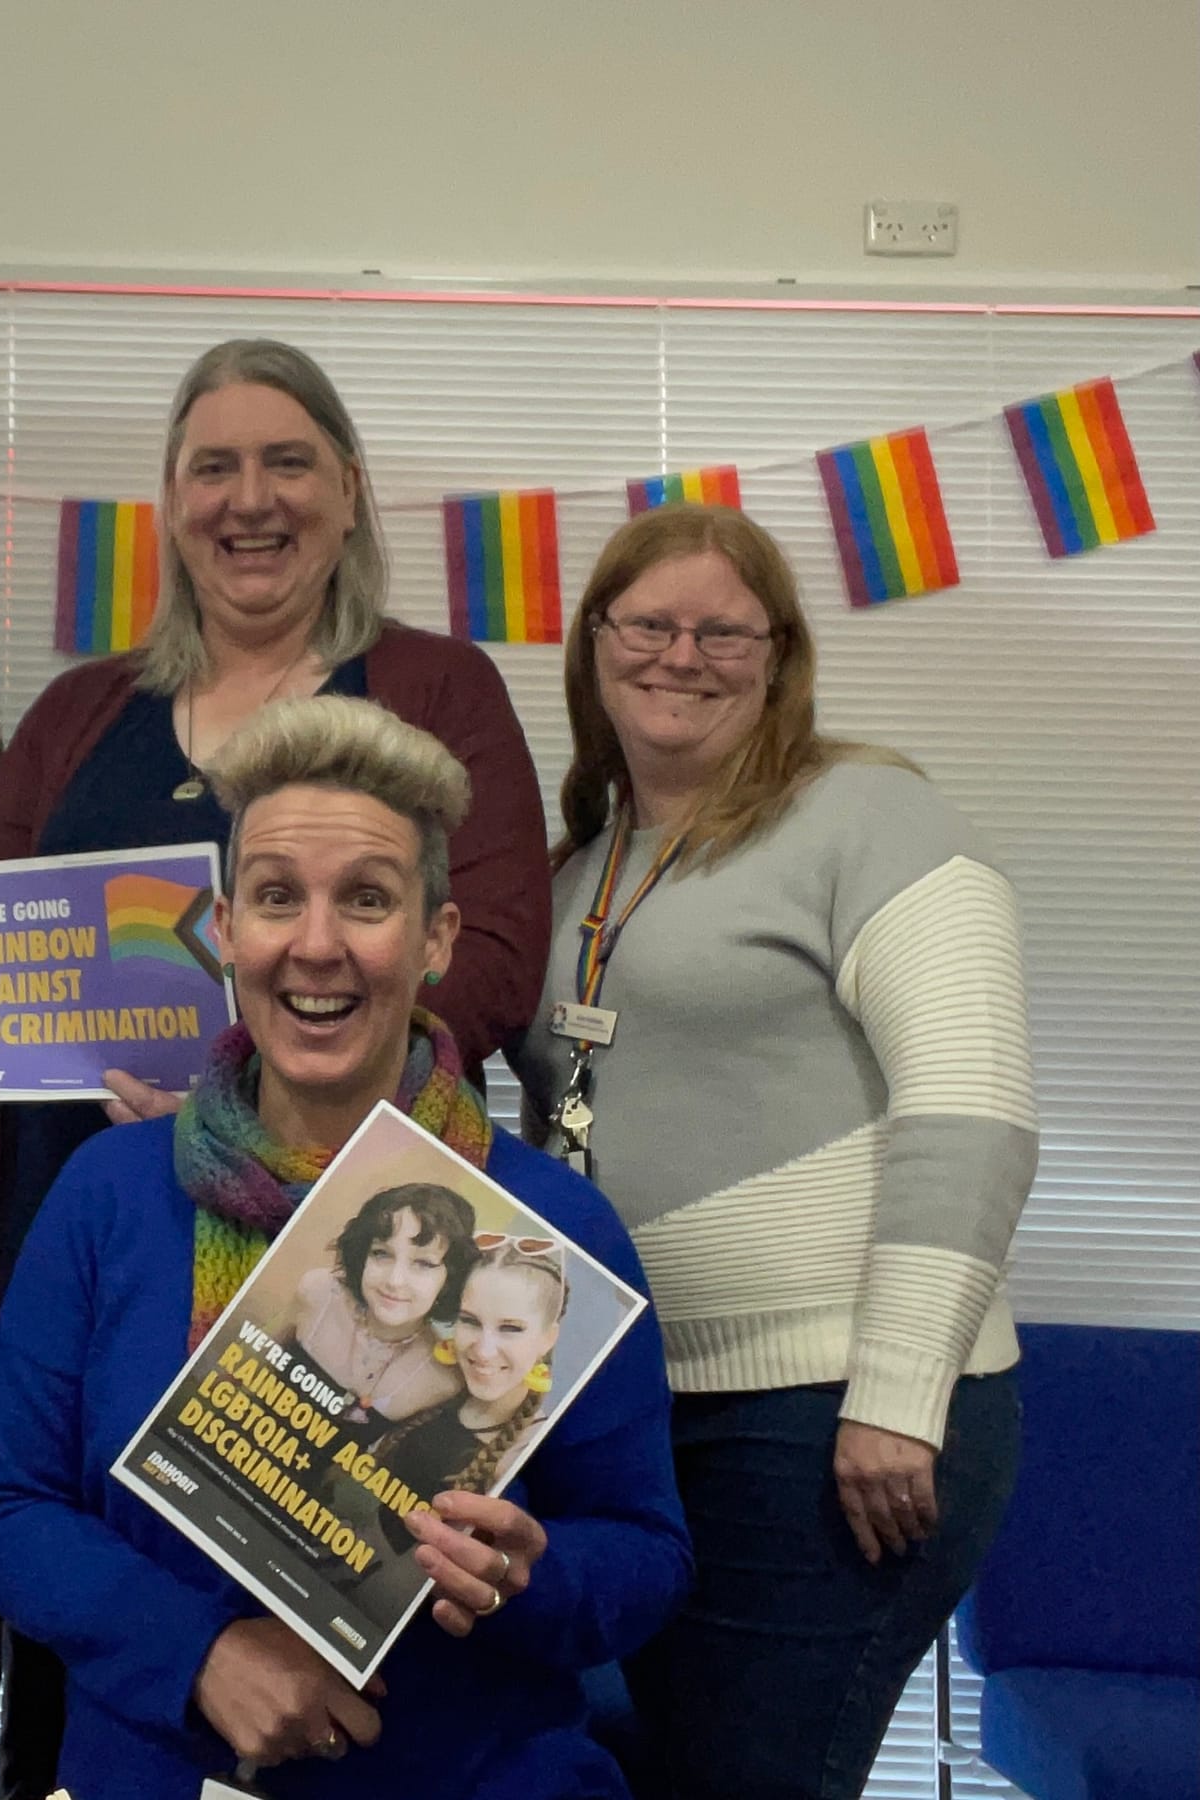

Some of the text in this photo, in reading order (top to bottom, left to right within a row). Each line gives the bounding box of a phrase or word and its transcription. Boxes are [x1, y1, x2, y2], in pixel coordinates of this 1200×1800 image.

[12, 898, 71, 922] GOING
[238, 1319, 346, 1416] WE'RE GOING
[197, 1370, 312, 1473] LGBTQIA+
[216, 1342, 339, 1449] RAINBOW
[332, 1439, 442, 1521] AGAIN
[147, 1450, 200, 1497] IDAHOBIT
[177, 1398, 376, 1575] DISCRIMINATION
